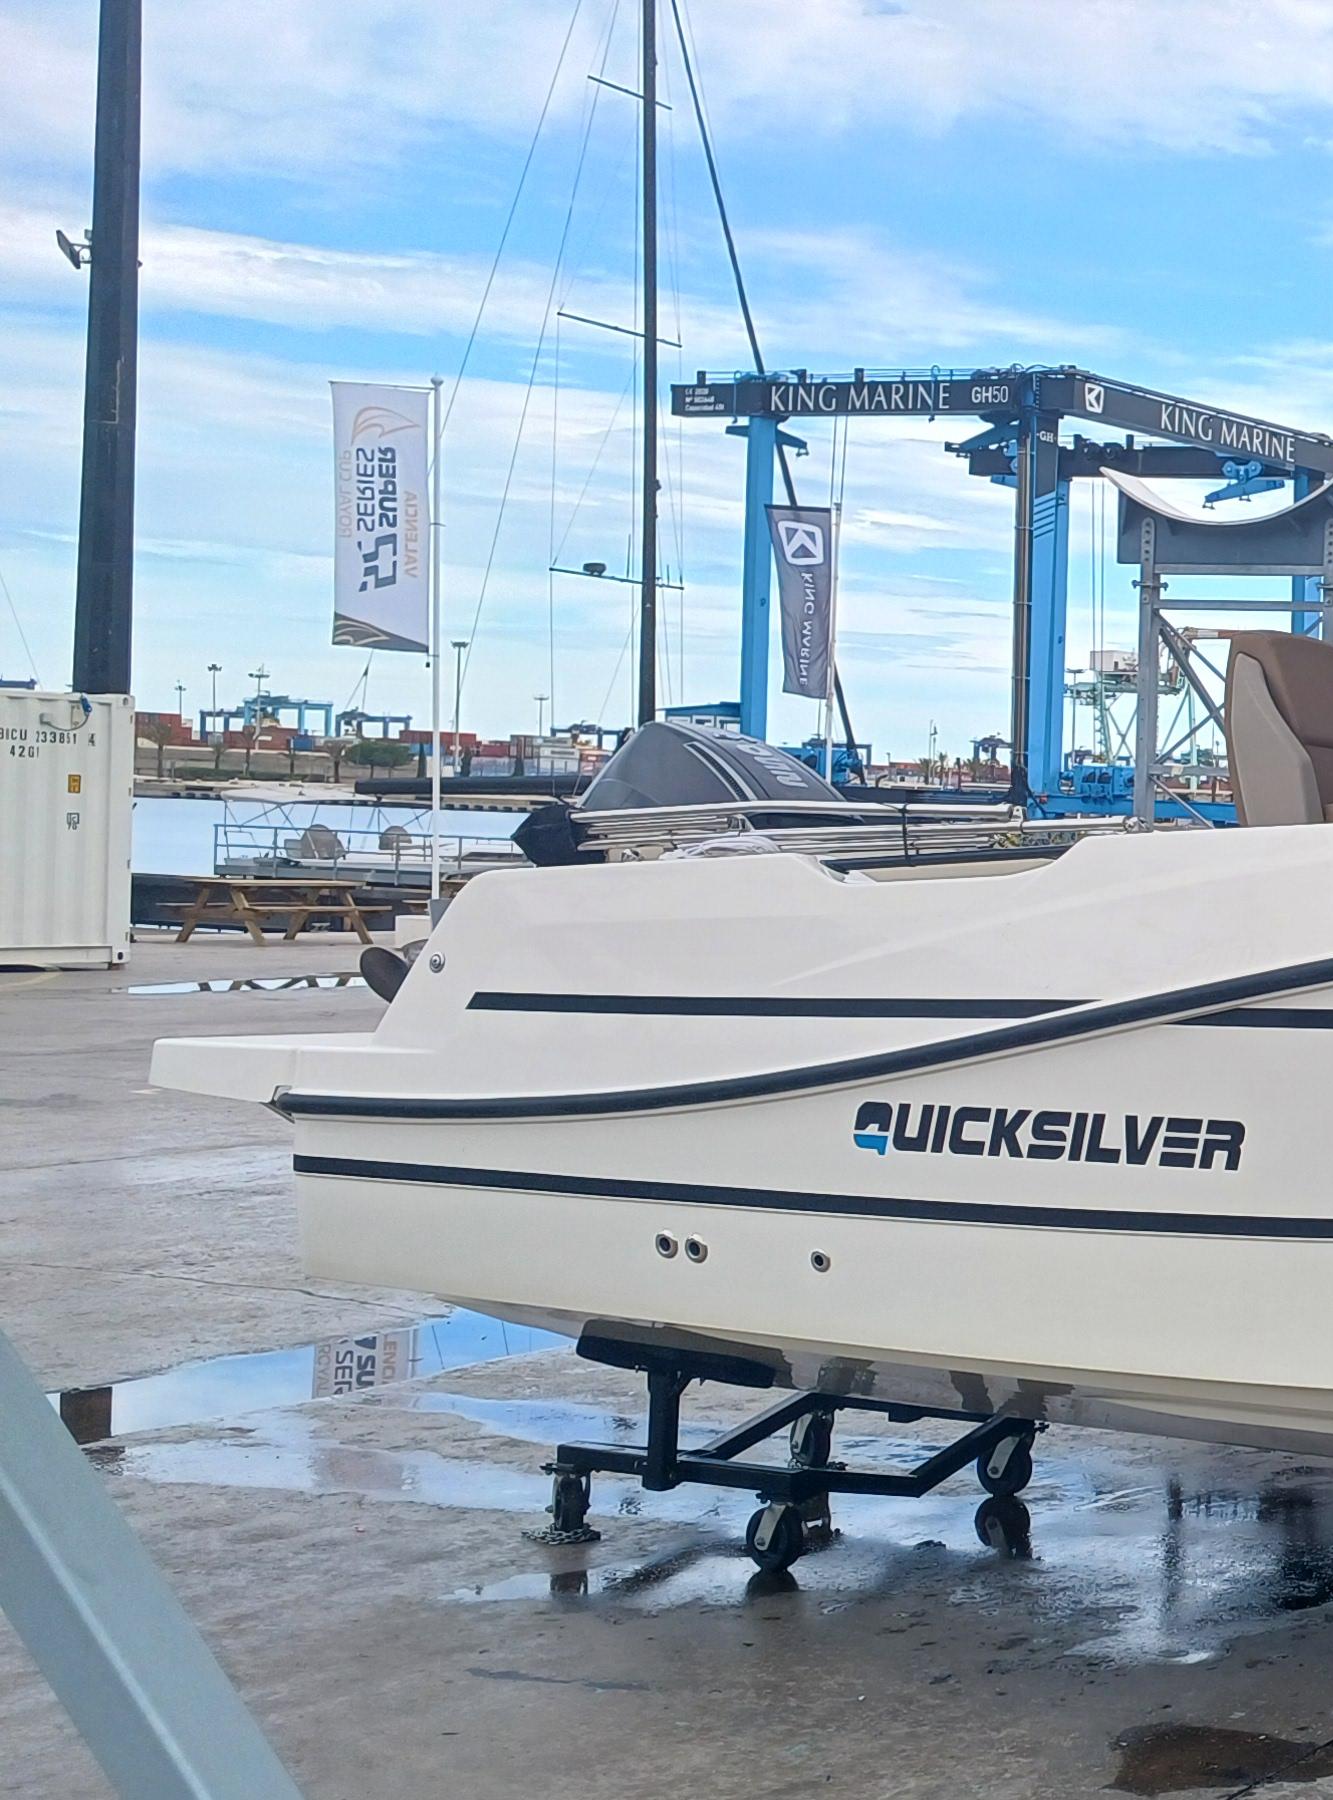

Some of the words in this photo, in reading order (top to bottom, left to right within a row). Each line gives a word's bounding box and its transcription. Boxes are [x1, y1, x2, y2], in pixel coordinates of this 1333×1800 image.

[770, 385, 837, 411] KING
[848, 382, 950, 411] MARINE
[971, 385, 1009, 405] GH50
[1160, 404, 1213, 441] KING
[1220, 419, 1296, 462] MARINE
[853, 1101, 1246, 1171] QUICKSILVER
